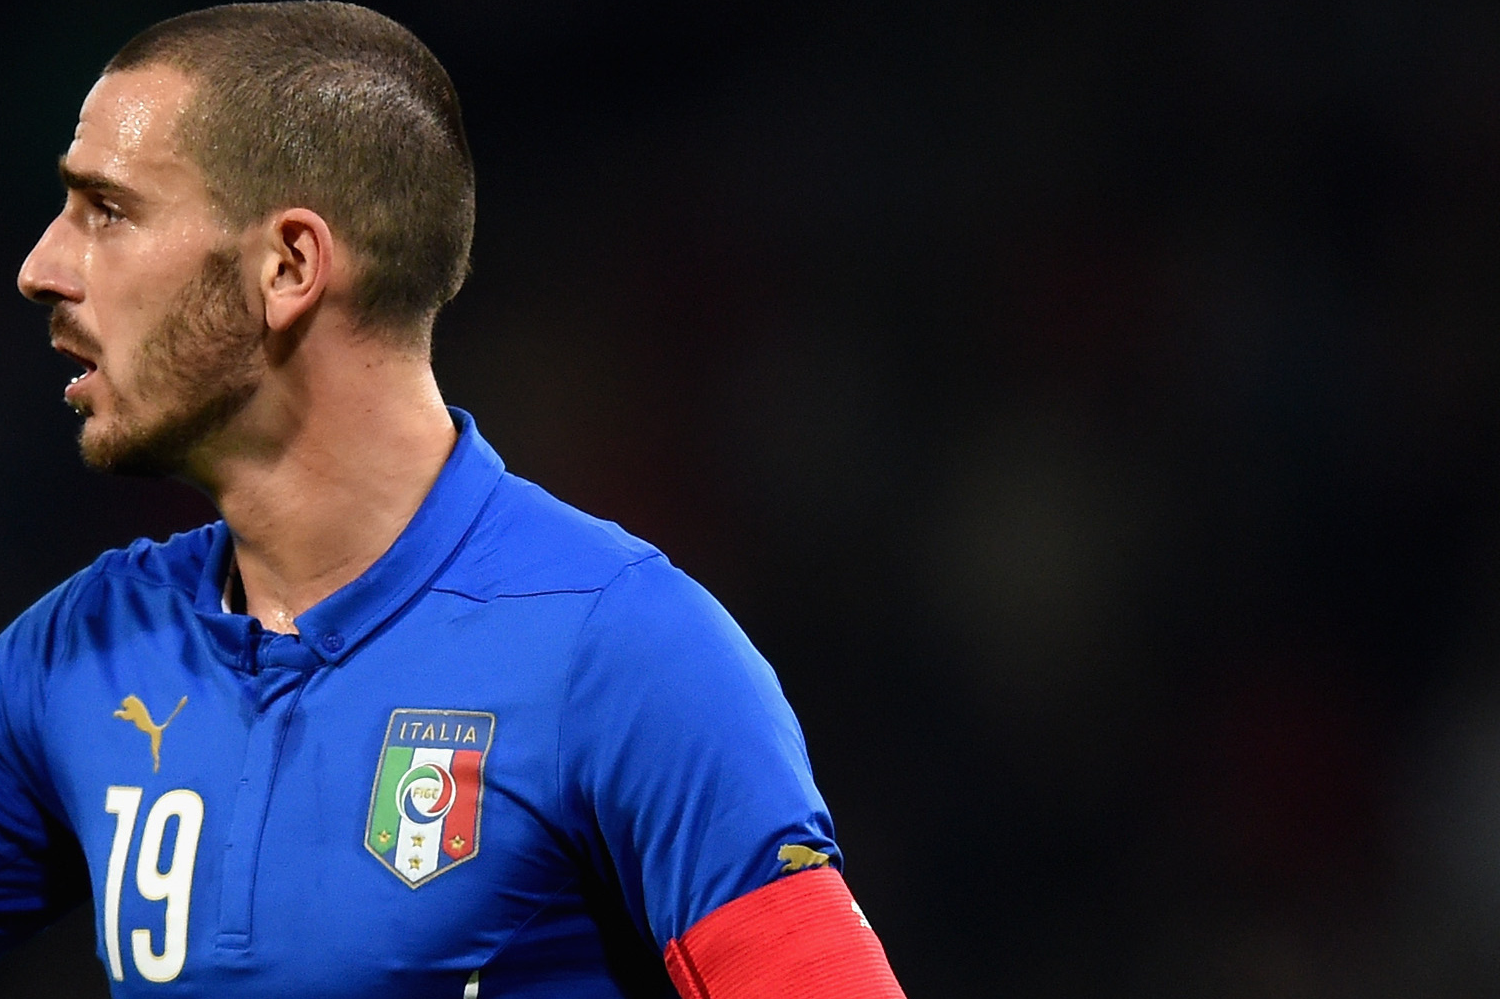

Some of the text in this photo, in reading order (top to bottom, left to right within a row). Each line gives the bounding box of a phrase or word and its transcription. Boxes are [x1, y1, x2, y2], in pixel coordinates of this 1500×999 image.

[400, 722, 477, 743] ITALIA
[413, 783, 439, 800] FIGC
[104, 785, 204, 983] 19
